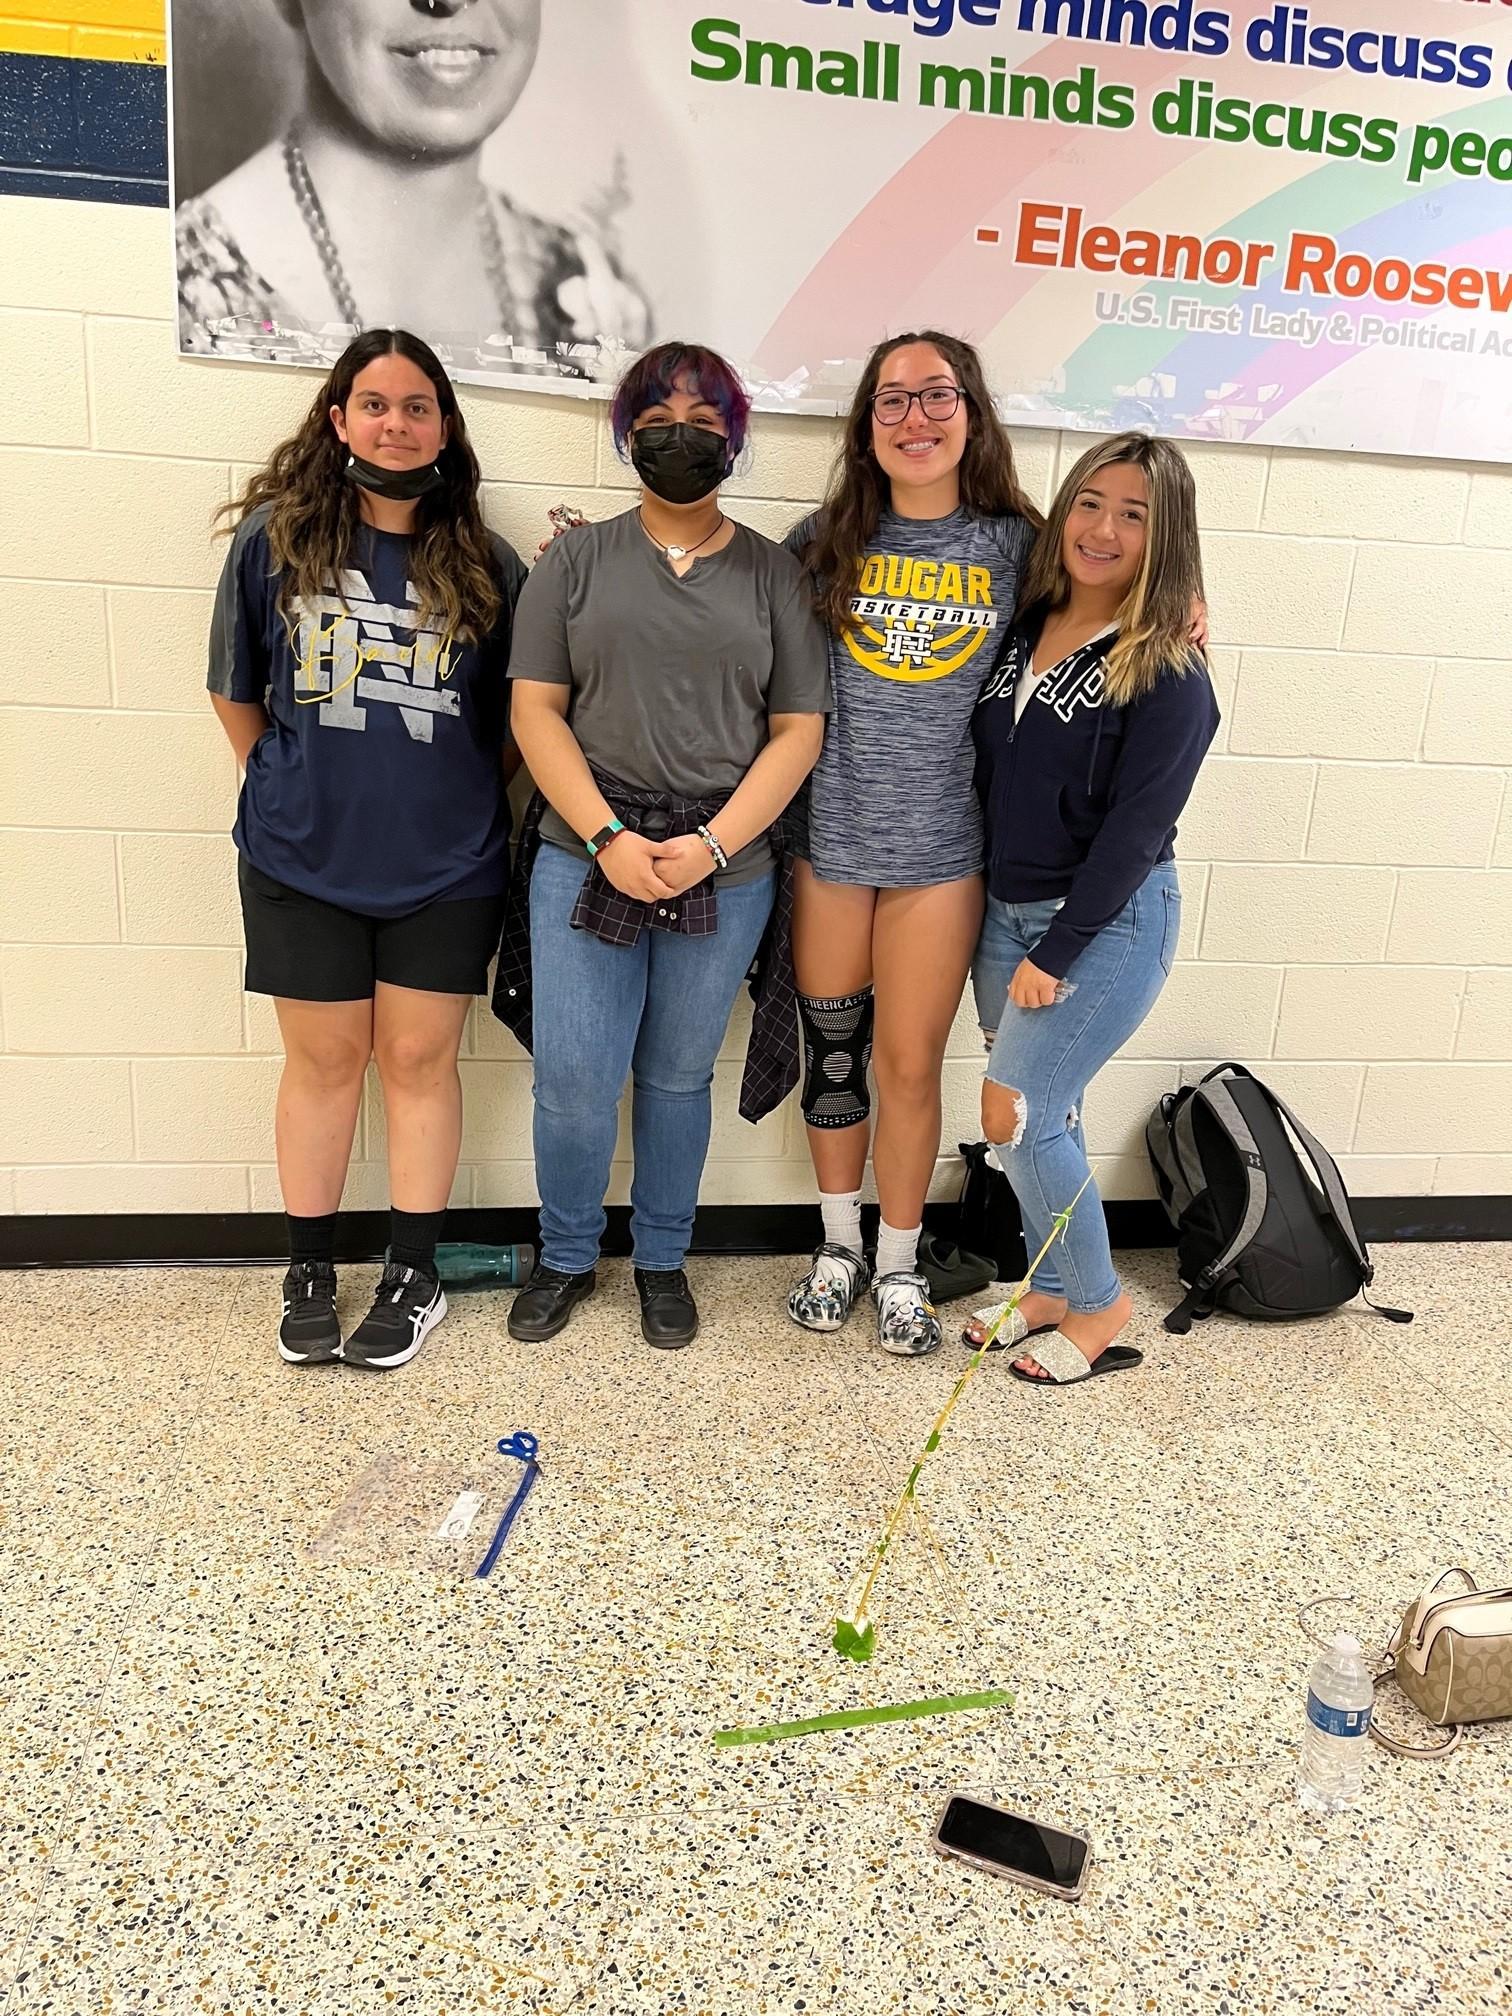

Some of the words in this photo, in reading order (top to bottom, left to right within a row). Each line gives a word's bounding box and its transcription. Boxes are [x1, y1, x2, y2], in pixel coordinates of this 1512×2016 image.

[1018, 0, 1229, 55] minds
[1247, 5, 1493, 88] discuss
[690, 18, 901, 102] Small
[918, 57, 1136, 128] minds
[1152, 80, 1398, 162] discuss
[1015, 202, 1274, 287] Eleanor
[1096, 293, 1159, 327] U.S.
[1169, 299, 1241, 332] First
[1253, 306, 1321, 344] Lady
[1329, 313, 1353, 342] &
[1360, 317, 1476, 353] Political
[850, 599, 991, 626] ASKETBALL
[857, 554, 992, 606] OUGAR
